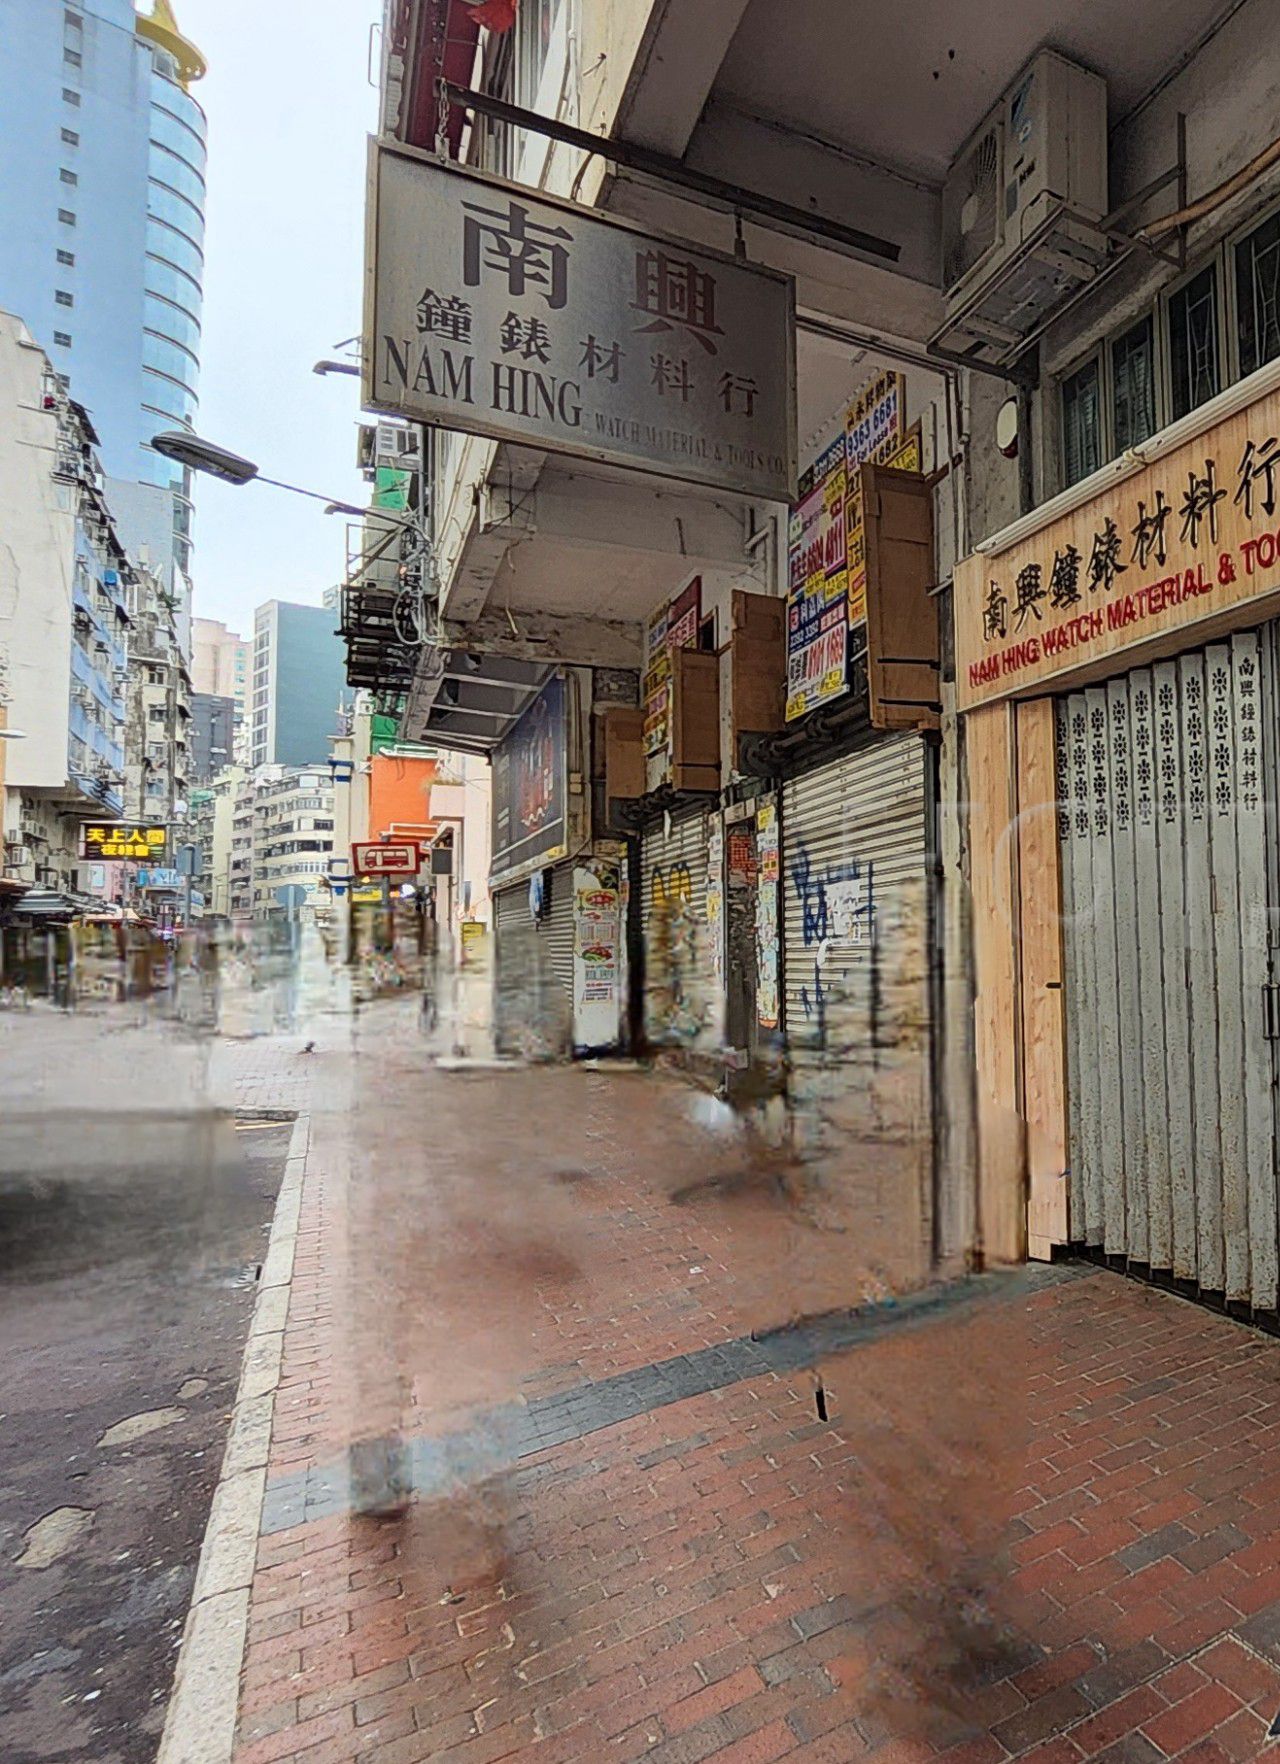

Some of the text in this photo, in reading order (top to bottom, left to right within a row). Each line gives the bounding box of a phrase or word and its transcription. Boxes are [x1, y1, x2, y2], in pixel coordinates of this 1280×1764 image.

[383, 335, 477, 404] NAM
[489, 360, 583, 428] HING
[595, 412, 640, 443] WATCH
[646, 424, 708, 458] MATERIAL
[968, 650, 1001, 688] NAM
[1002, 637, 1041, 675] HING
[1041, 607, 1104, 658] WATCH
[1106, 562, 1213, 631] MATERIAL
[1218, 552, 1238, 586] &
